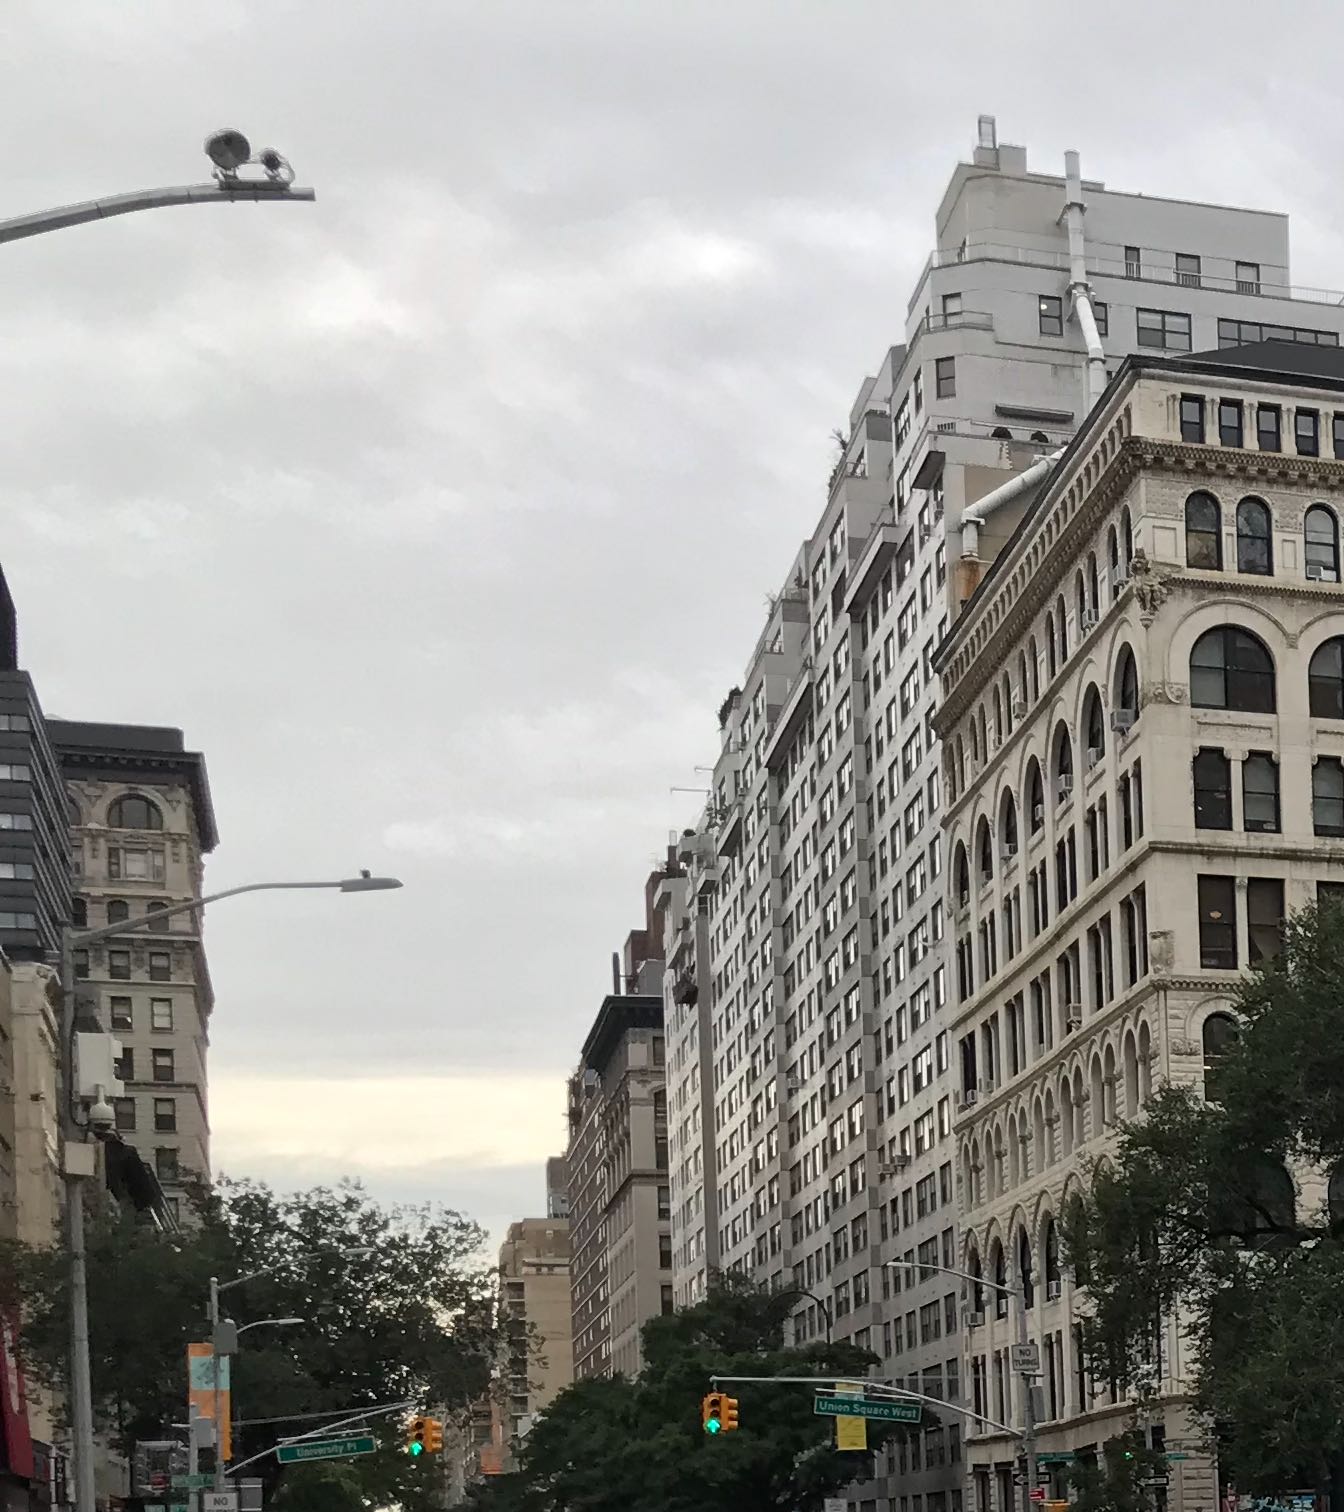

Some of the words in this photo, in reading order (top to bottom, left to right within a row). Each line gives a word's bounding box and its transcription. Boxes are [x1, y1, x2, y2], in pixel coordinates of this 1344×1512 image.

[1019, 1348, 1031, 1357] NO
[820, 1401, 850, 1412] Union
[852, 1403, 889, 1416] Square
[892, 1407, 917, 1418] West
[296, 1444, 344, 1458] University
[213, 1496, 228, 1506] NO
